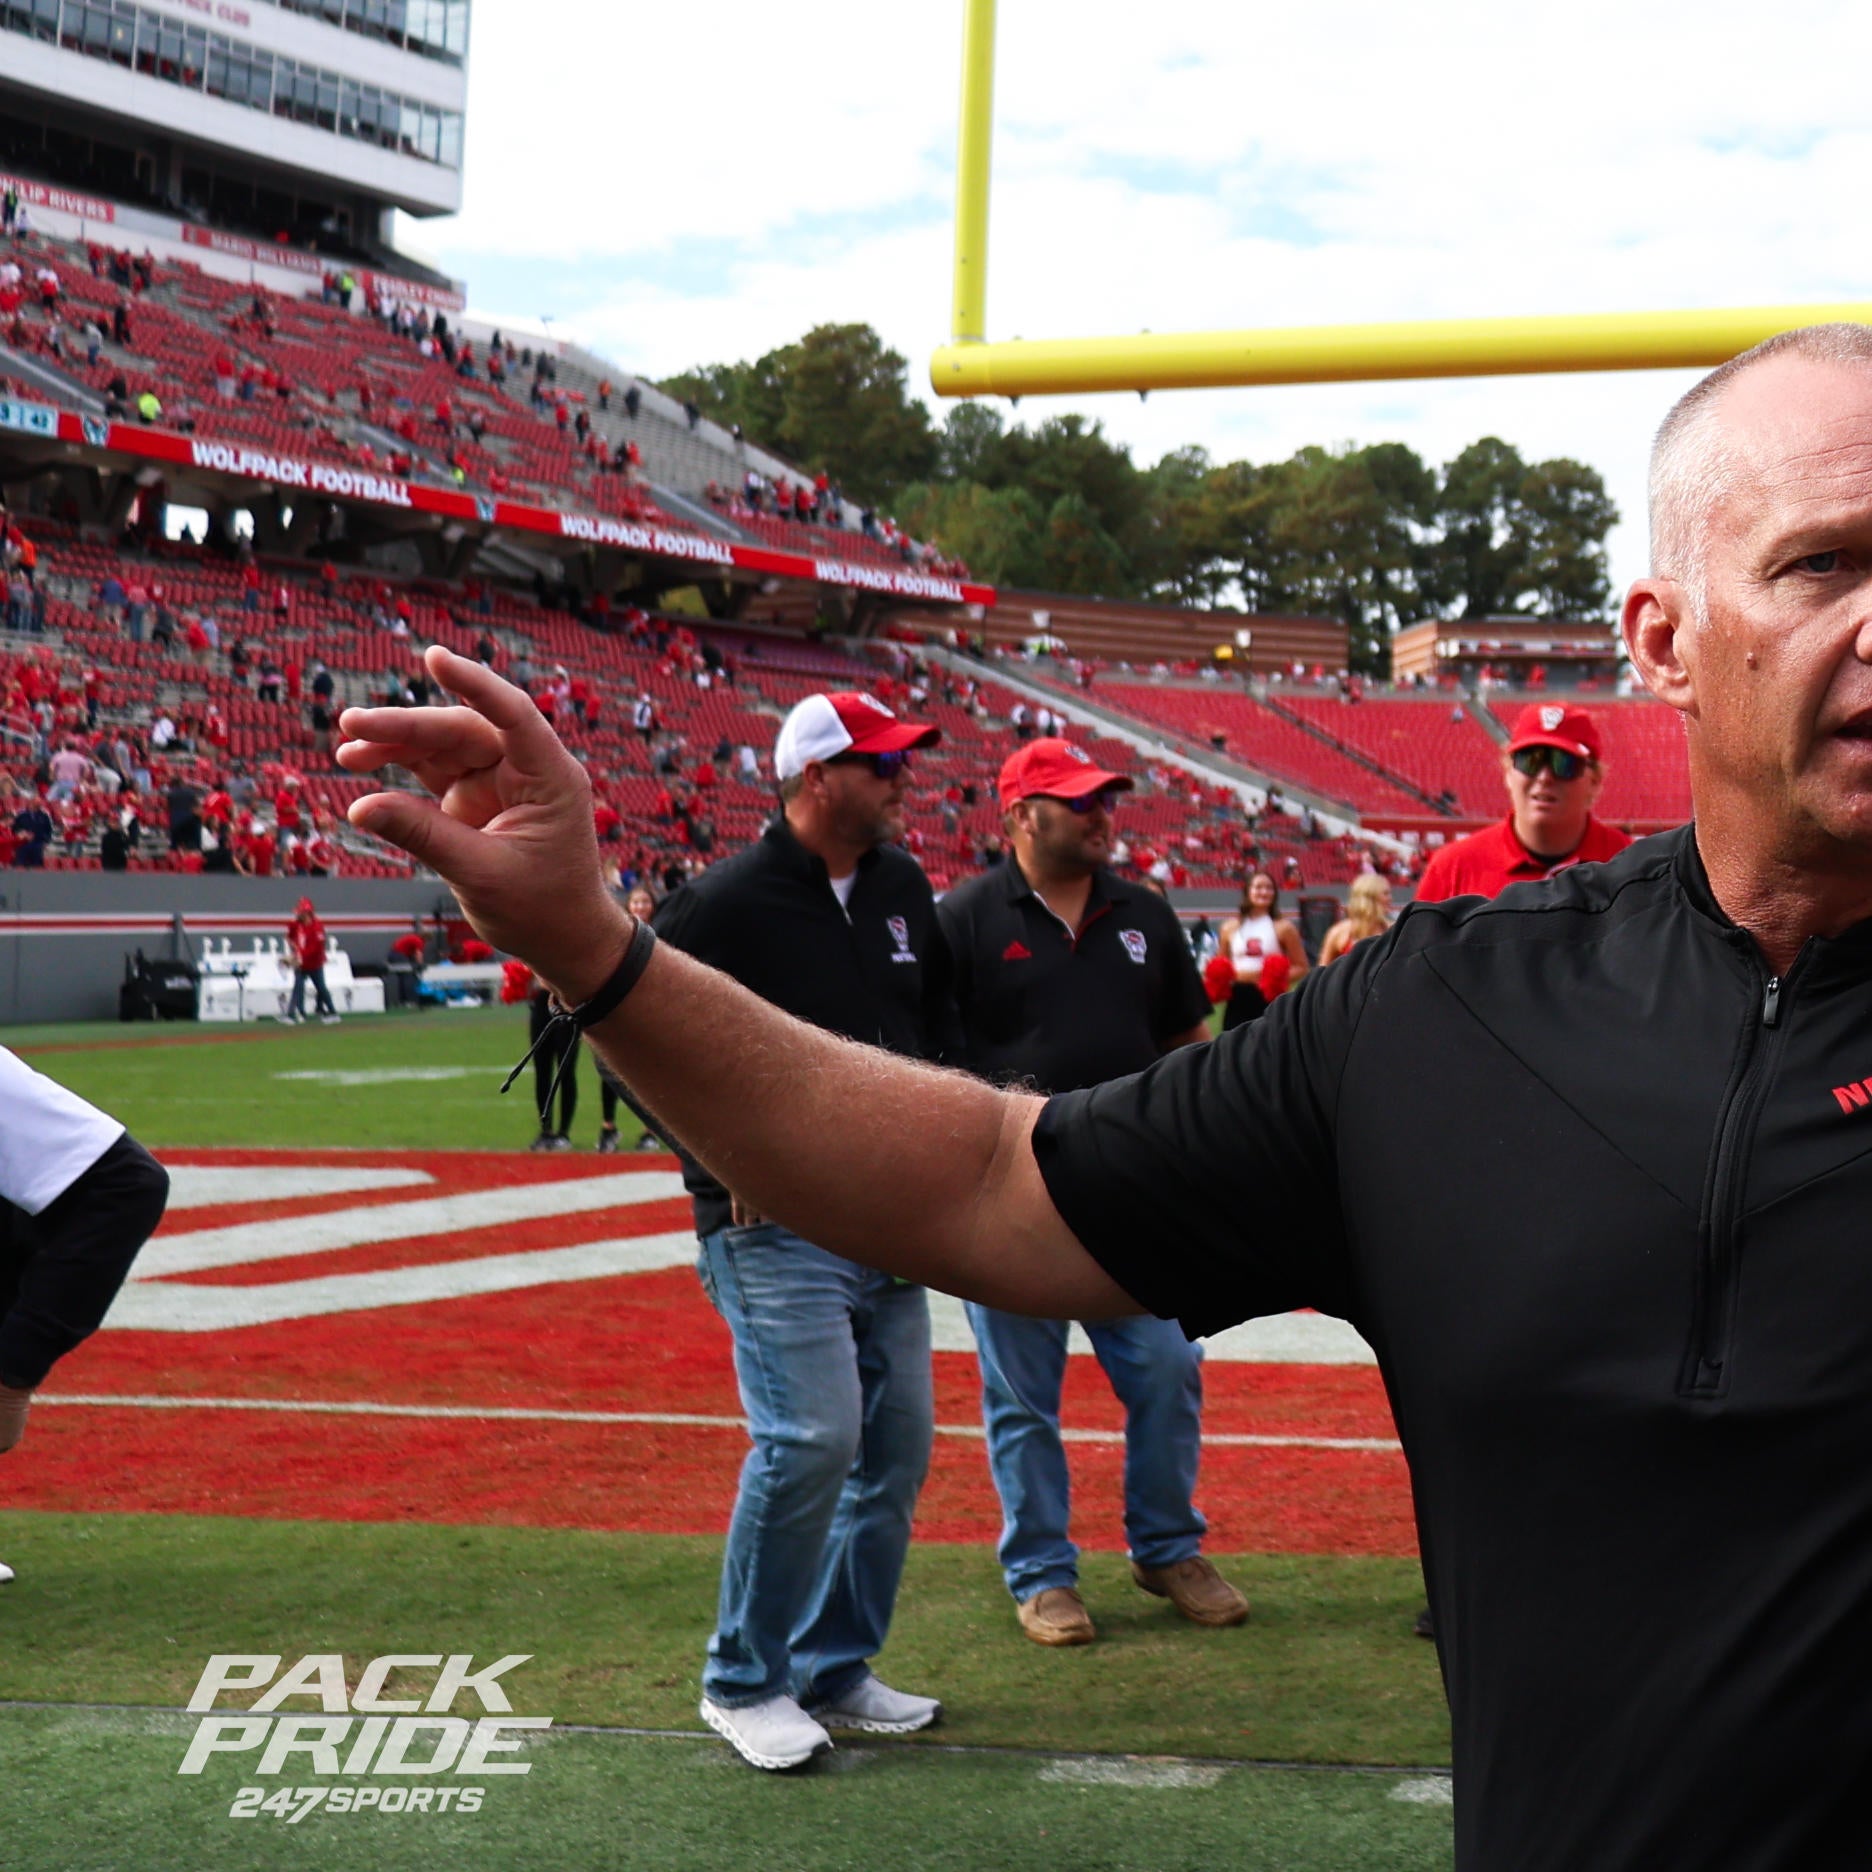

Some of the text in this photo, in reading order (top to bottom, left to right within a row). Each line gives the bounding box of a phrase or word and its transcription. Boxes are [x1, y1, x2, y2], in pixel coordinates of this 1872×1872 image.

[48, 189, 108, 220] RIVERS
[191, 440, 413, 507] WOLFPACK FOOTBALL
[561, 515, 735, 565] WOLFPACK FOOTBALL
[816, 560, 965, 600] WOLFPACK FOOTBALL
